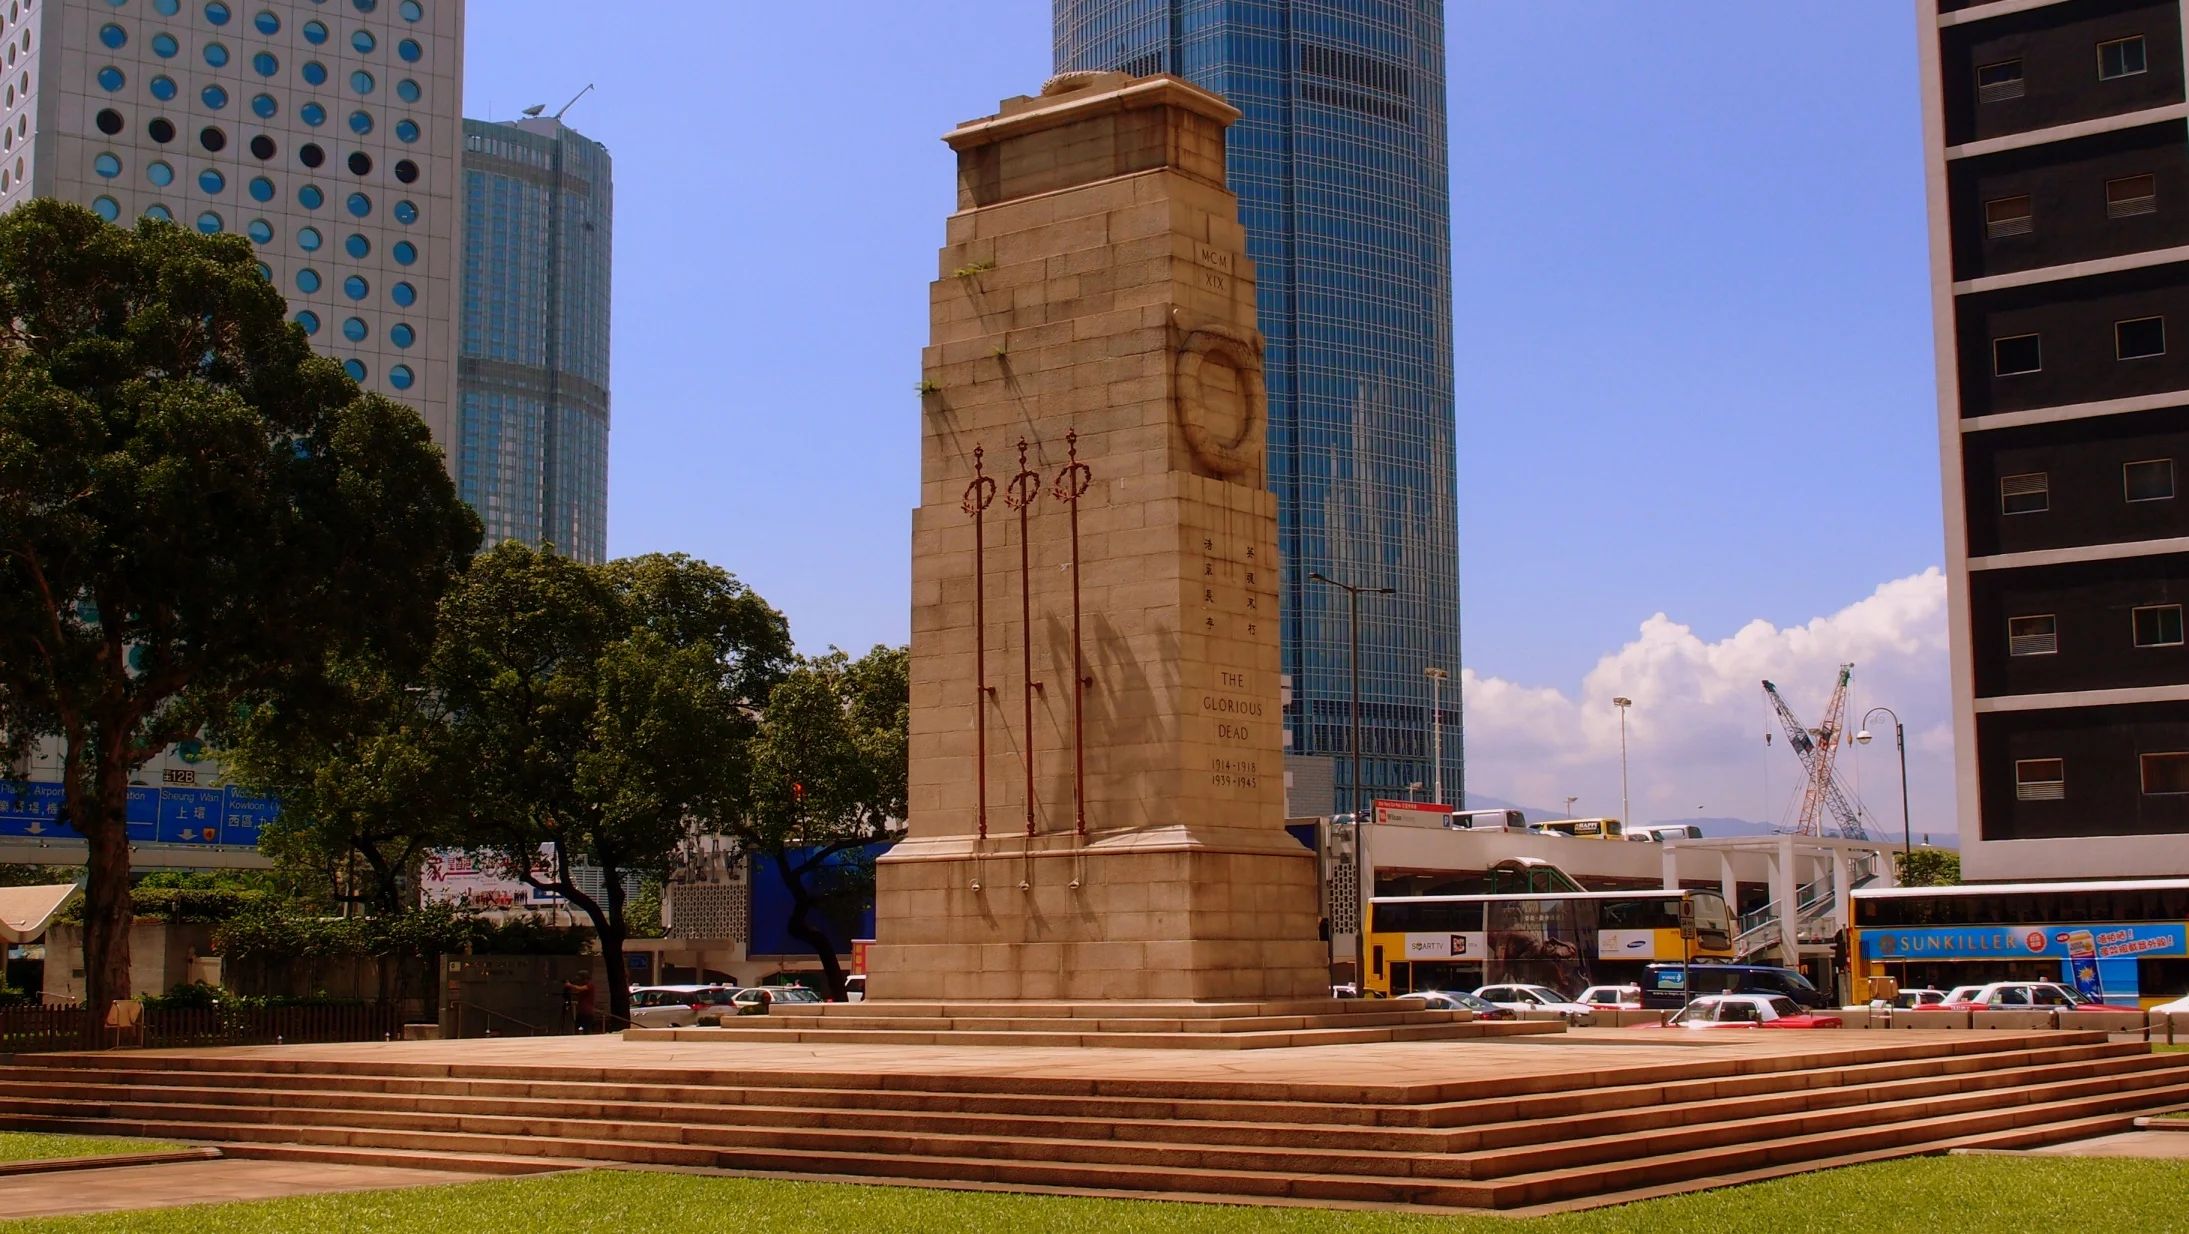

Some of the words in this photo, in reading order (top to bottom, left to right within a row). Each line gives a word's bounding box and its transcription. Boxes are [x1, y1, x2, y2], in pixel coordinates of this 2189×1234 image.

[1202, 249, 1227, 268] MCM
[1205, 272, 1224, 290] XIX
[1221, 672, 1244, 688] THE
[1203, 696, 1262, 716] GLORIOUS
[1218, 724, 1248, 740] DEAD
[171, 770, 194, 783] 12B
[34, 786, 65, 797] Airport
[162, 790, 195, 803] Sheung
[200, 792, 219, 802] Wan
[176, 806, 206, 820] 上環
[230, 800, 265, 810] Kowloon
[1901, 934, 2017, 951] SUNKILLER
